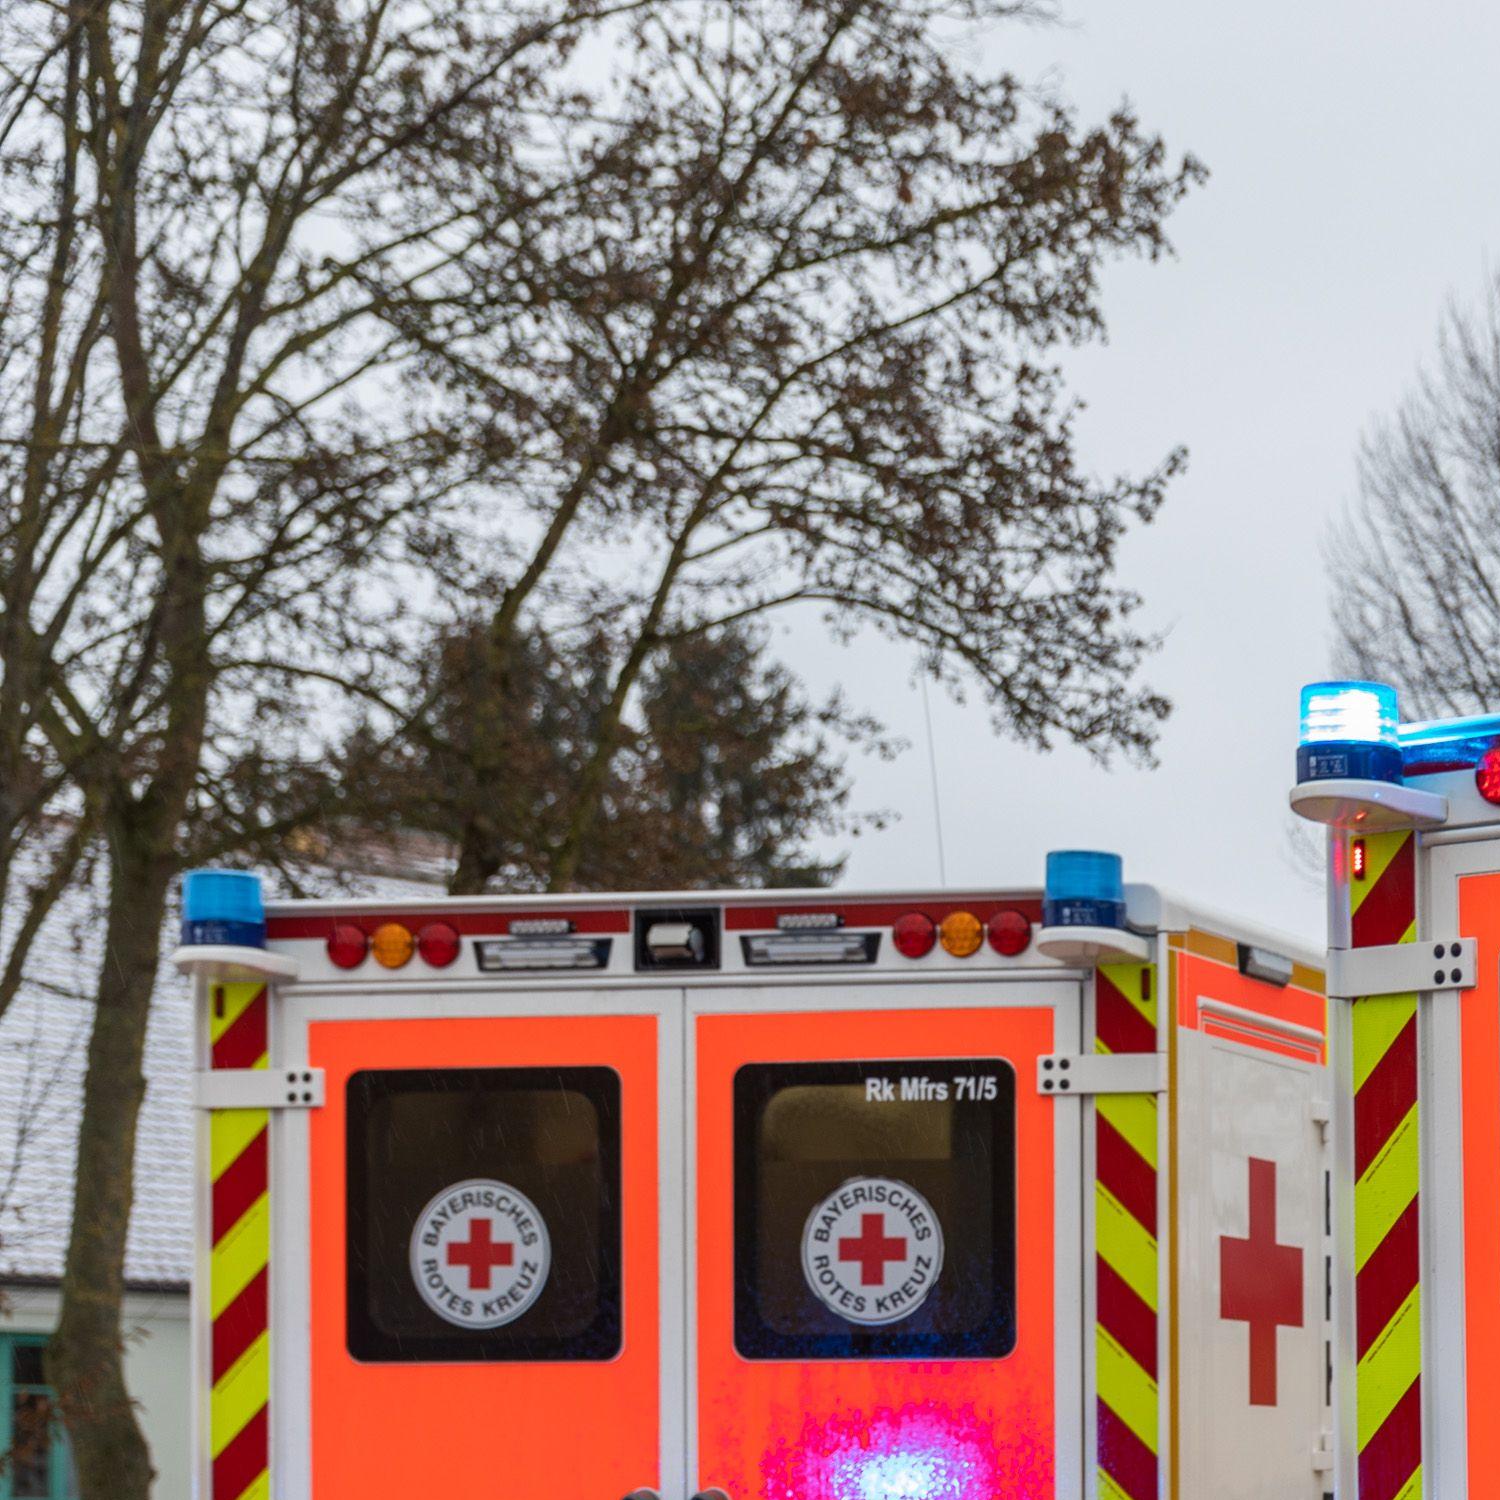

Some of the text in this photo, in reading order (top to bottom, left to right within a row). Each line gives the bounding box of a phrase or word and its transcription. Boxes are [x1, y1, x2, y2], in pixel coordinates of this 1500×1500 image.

[865, 1075, 997, 1102] Rk Mfrs 71/5
[422, 1191, 538, 1247] BAYERISCHES
[814, 1185, 931, 1243] BAYERISCHES
[422, 1259, 538, 1318] ROTES KREUZ
[814, 1255, 932, 1313] ROTES KREUZ
